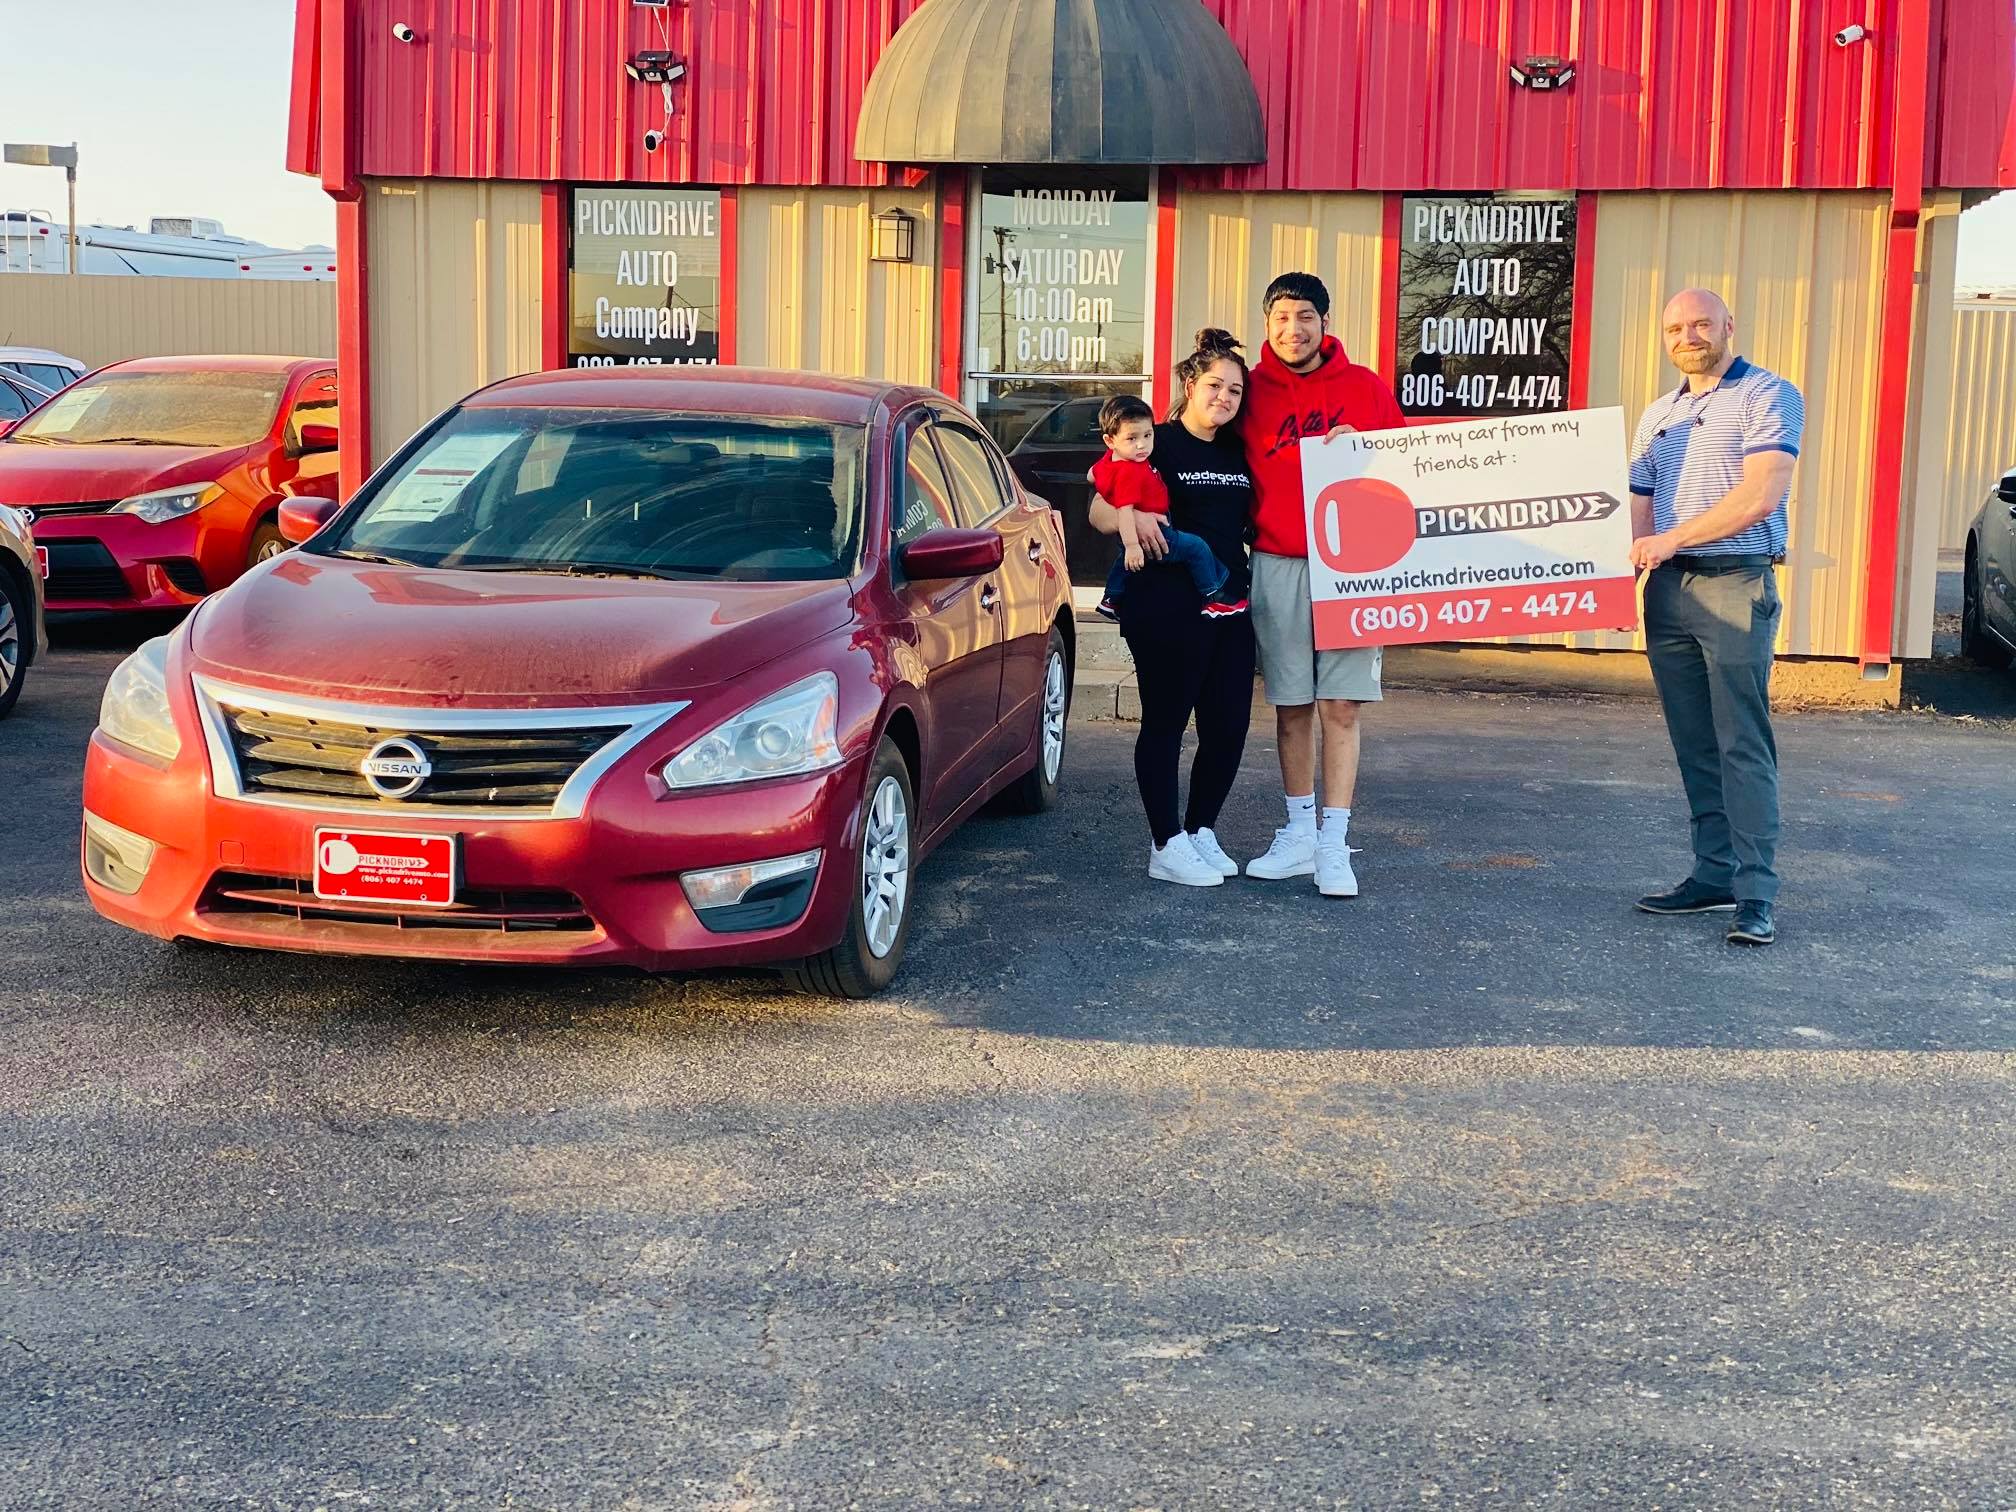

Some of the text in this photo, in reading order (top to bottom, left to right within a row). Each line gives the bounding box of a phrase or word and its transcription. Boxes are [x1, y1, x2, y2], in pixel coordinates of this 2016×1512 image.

[578, 200, 714, 237] PICKNDRIVE
[1013, 189, 1116, 226] MONDAY
[1414, 205, 1564, 243] PICKNDRIVE
[616, 250, 678, 287] AUTO
[1003, 248, 1124, 285] SATURDAY
[1452, 257, 1521, 296] AUTO
[595, 296, 700, 346] Company
[1013, 287, 1113, 323] 10:00am
[1017, 326, 1106, 371] 6:00pm
[1421, 317, 1548, 355] COMPANY
[1401, 373, 1561, 408] 806-407-4474
[1361, 430, 1431, 453] bought
[1435, 432, 1462, 449] my
[1468, 426, 1498, 441] car
[1501, 420, 1546, 442] from
[1551, 420, 1580, 437] my
[1413, 454, 1479, 478] friends
[1420, 495, 1611, 535] PICKNDRIVE
[1335, 559, 1595, 594] www.pickndriveauto.com
[1350, 604, 1429, 637] (806)
[1437, 599, 1492, 625] 407
[1522, 591, 1597, 618] 4474
[368, 763, 422, 775] NISSAN
